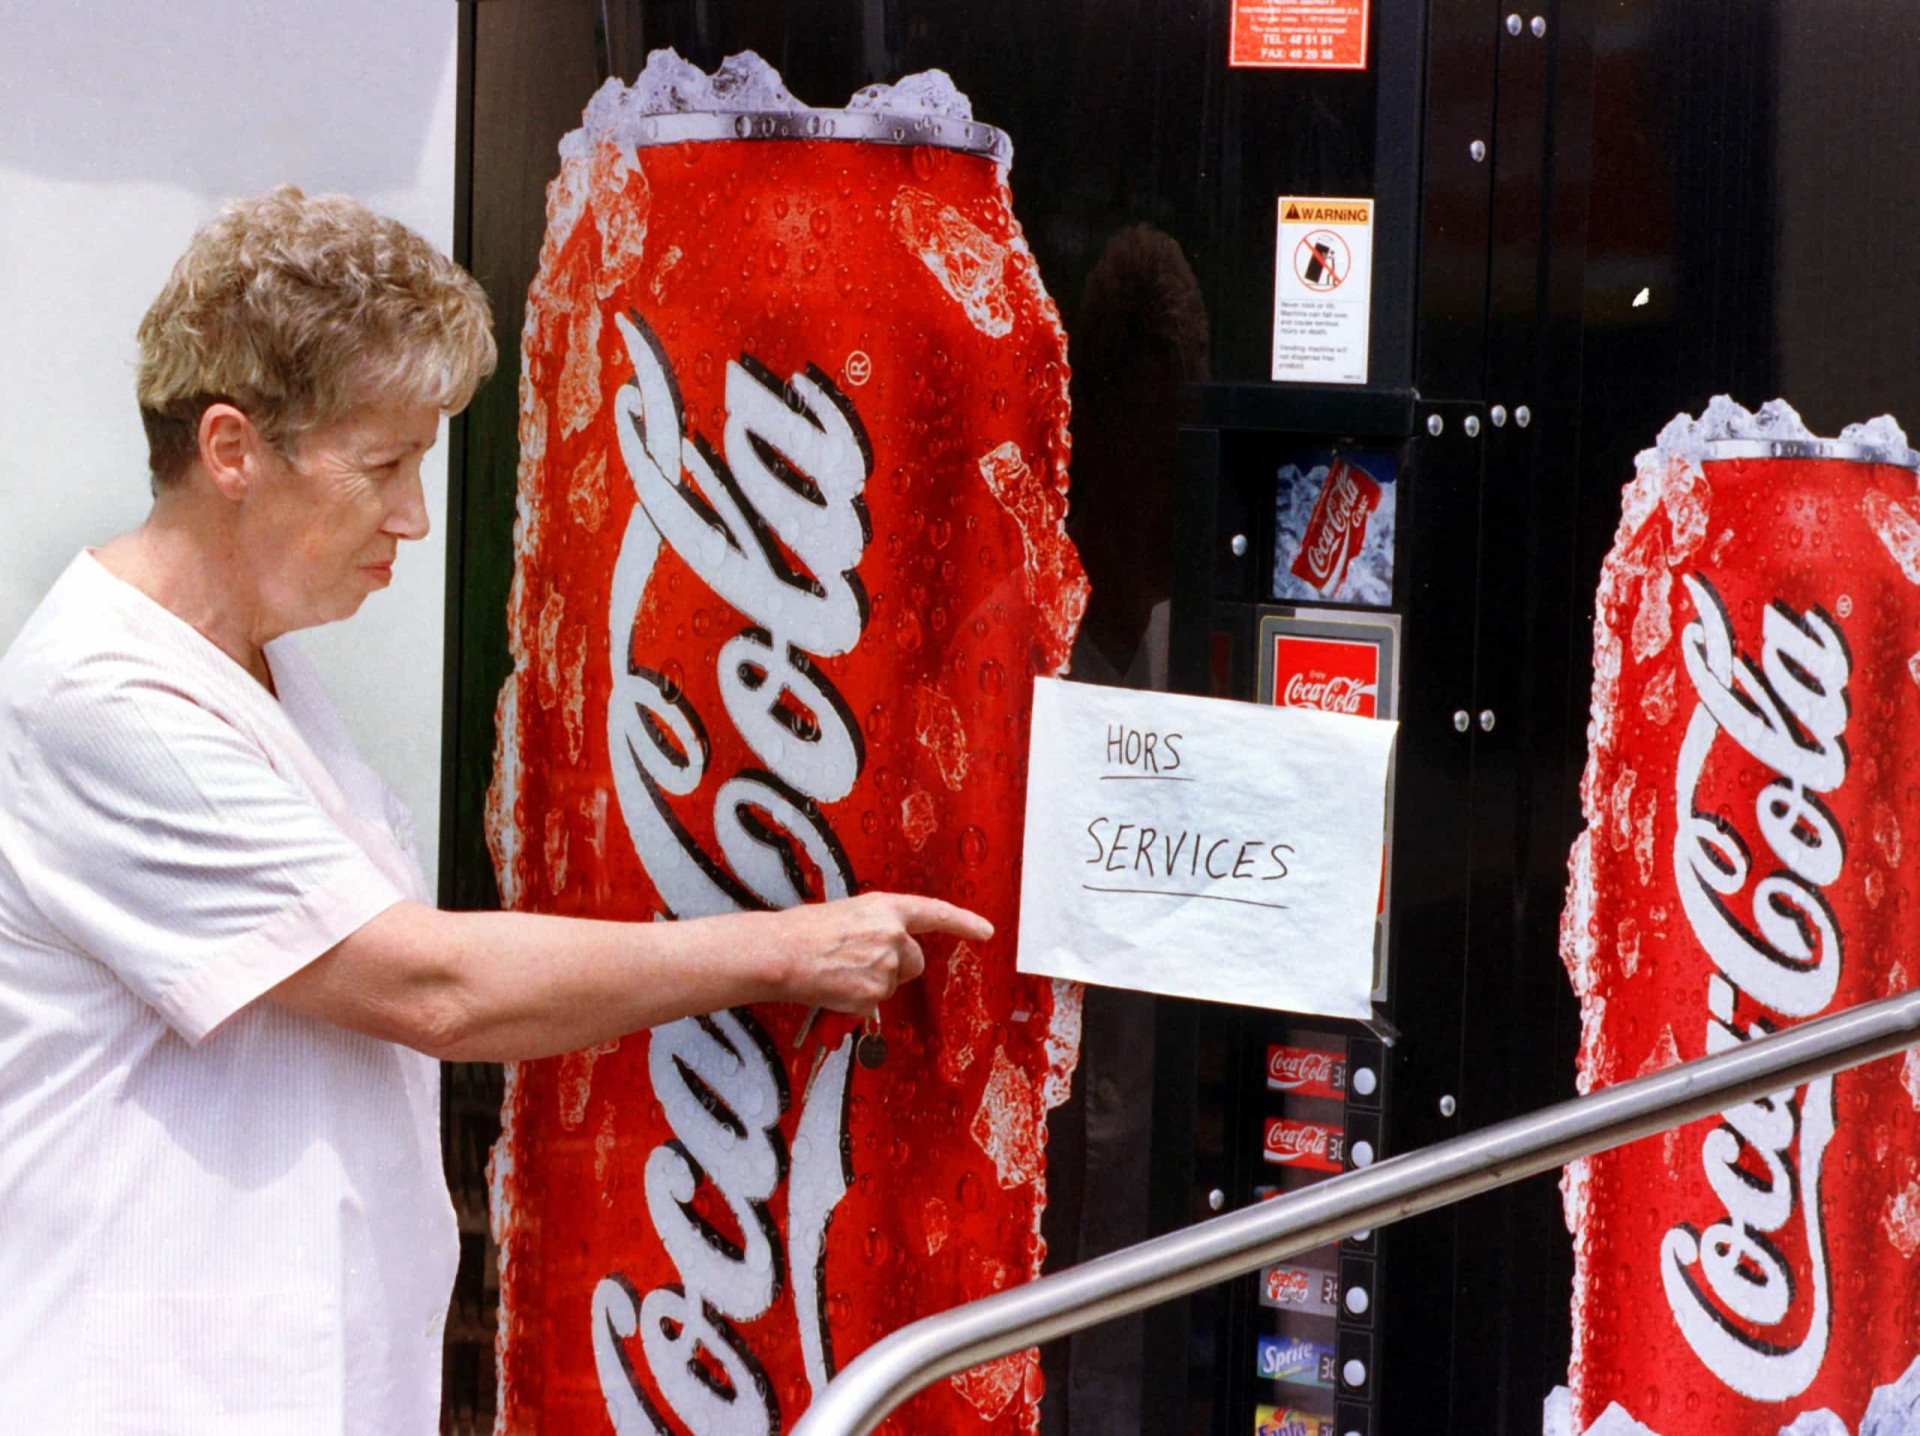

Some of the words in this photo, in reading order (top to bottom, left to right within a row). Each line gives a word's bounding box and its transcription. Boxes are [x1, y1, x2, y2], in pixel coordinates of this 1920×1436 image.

[1107, 724, 1183, 773] HORS
[592, 310, 870, 1436] CocaCola
[1086, 817, 1295, 881] SERVICES
[1262, 1339, 1314, 1375] Sprite
